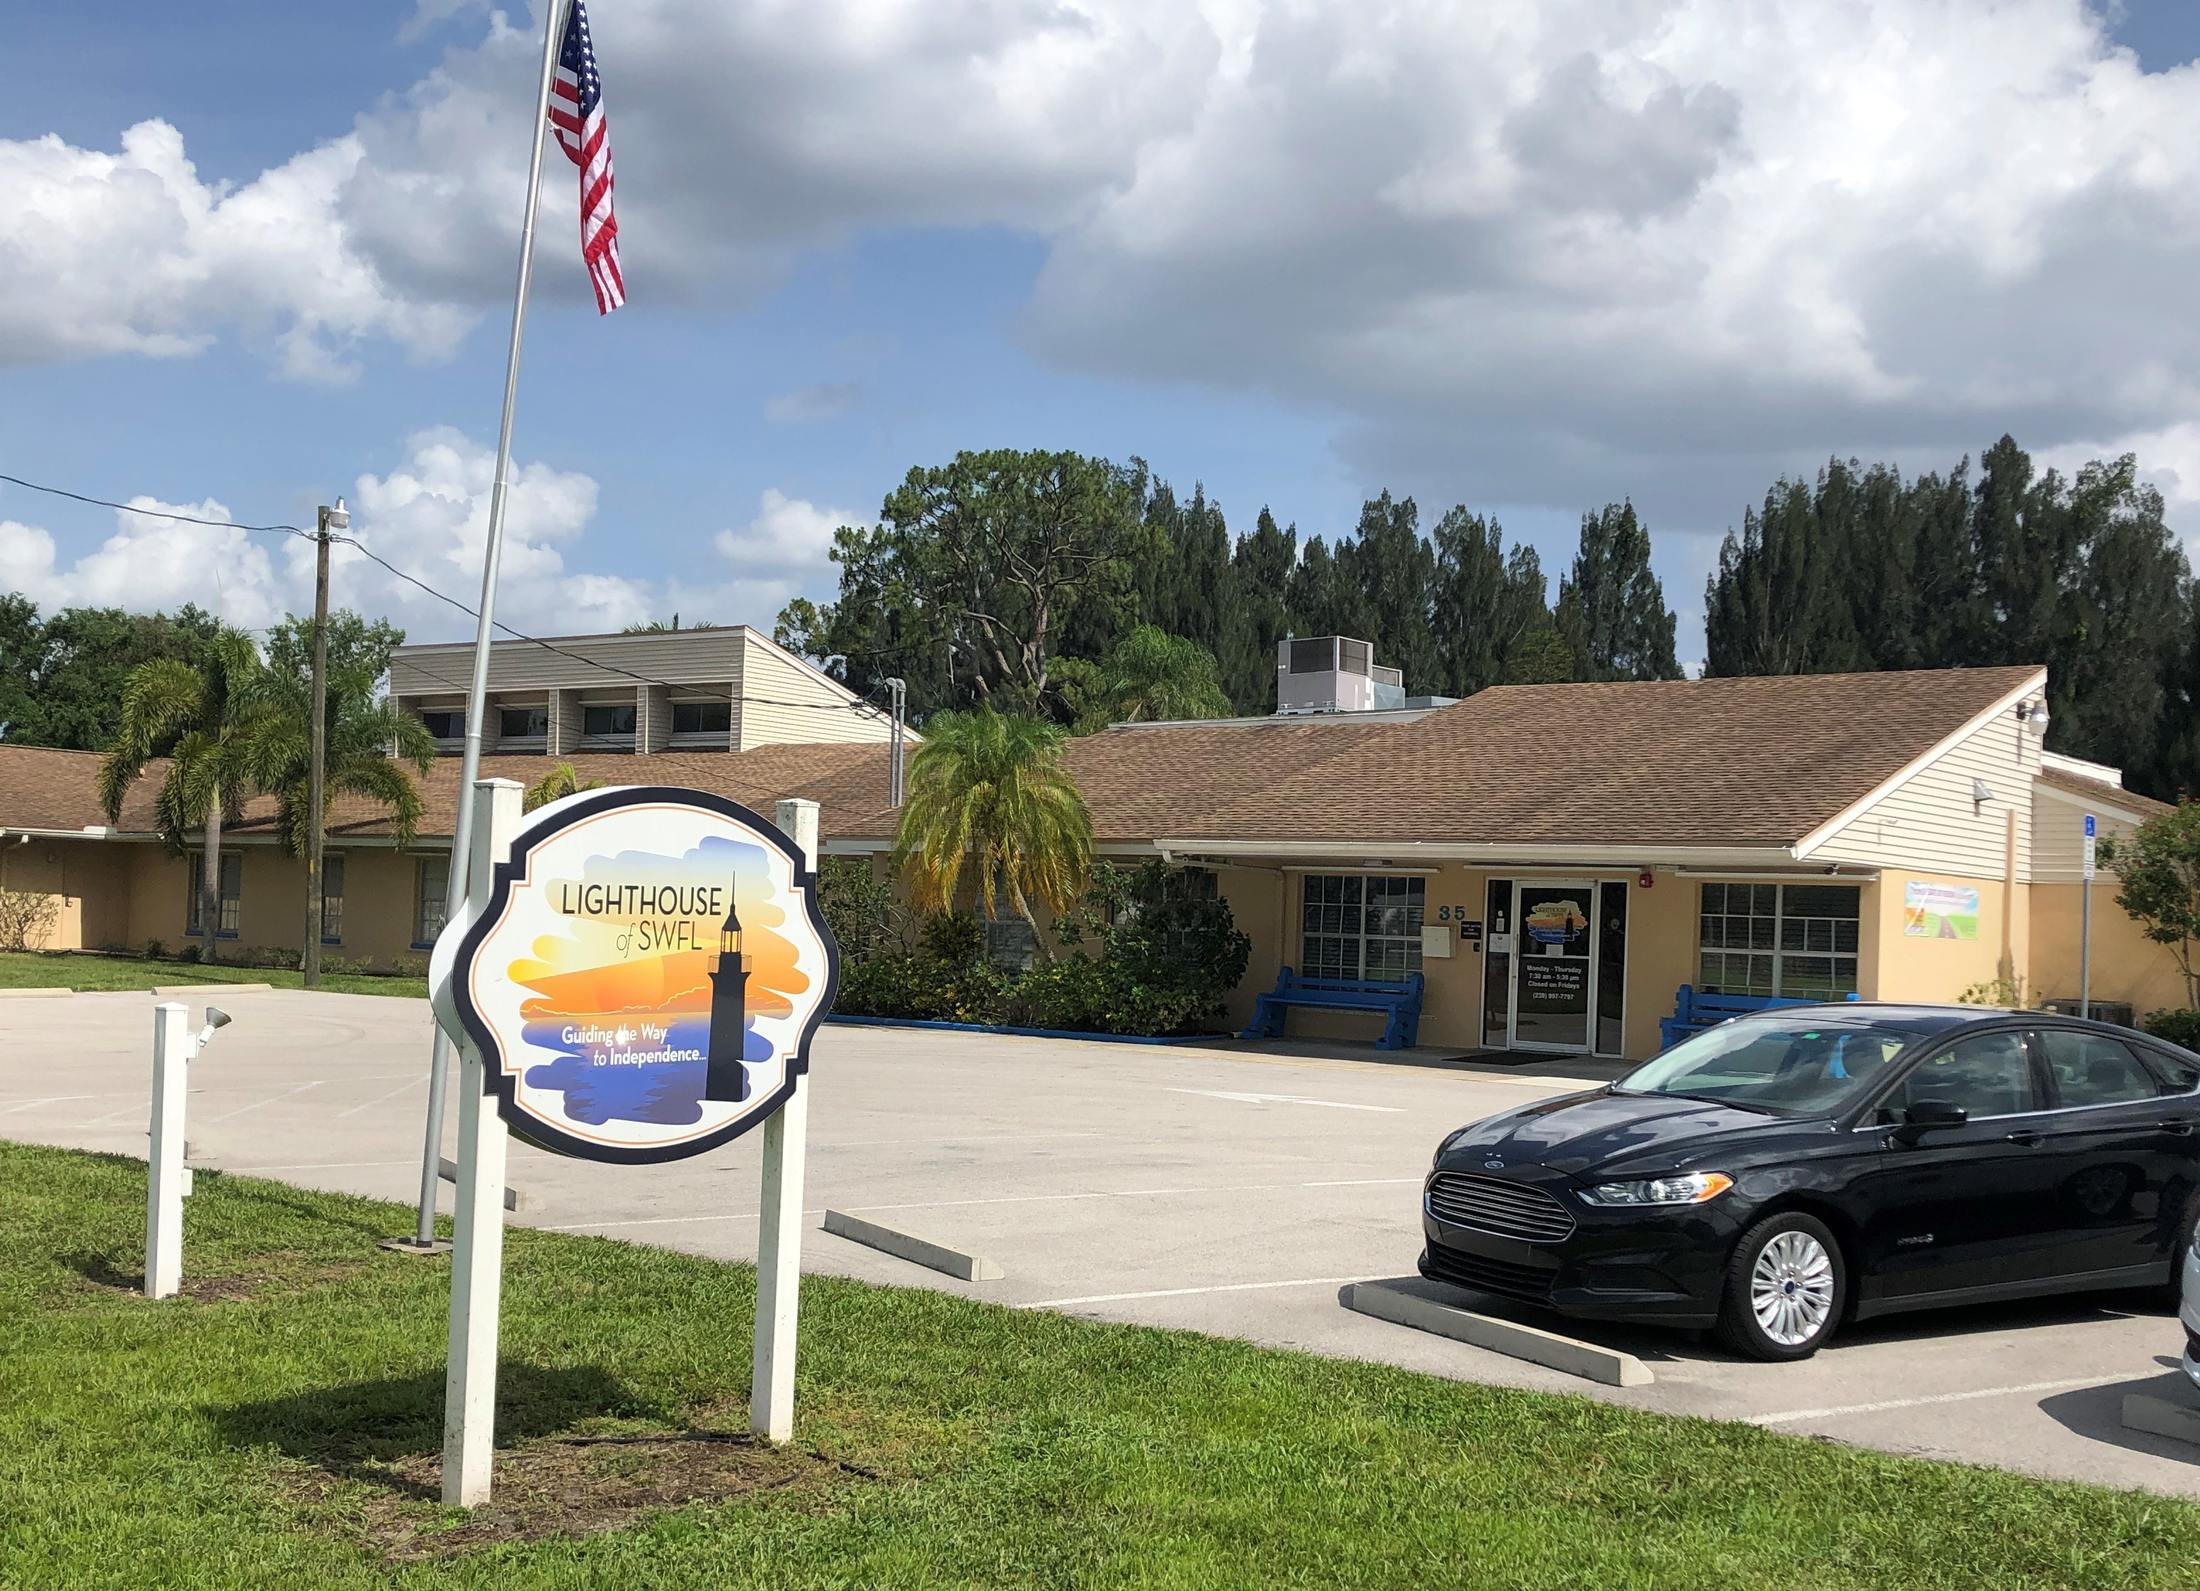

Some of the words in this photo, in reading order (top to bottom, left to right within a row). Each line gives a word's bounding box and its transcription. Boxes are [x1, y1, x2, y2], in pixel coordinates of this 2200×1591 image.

[562, 883, 723, 916] LIGHTHOUSE
[1439, 905, 1466, 921] 35
[616, 922, 636, 959] of
[638, 920, 703, 951] SWFL
[1526, 964, 1550, 973] Monday
[1554, 965, 1582, 975] Thursday
[1557, 981, 1580, 990] Fridays
[561, 1024, 614, 1047] Guiding
[640, 1023, 669, 1045] Way
[593, 1049, 607, 1067] to
